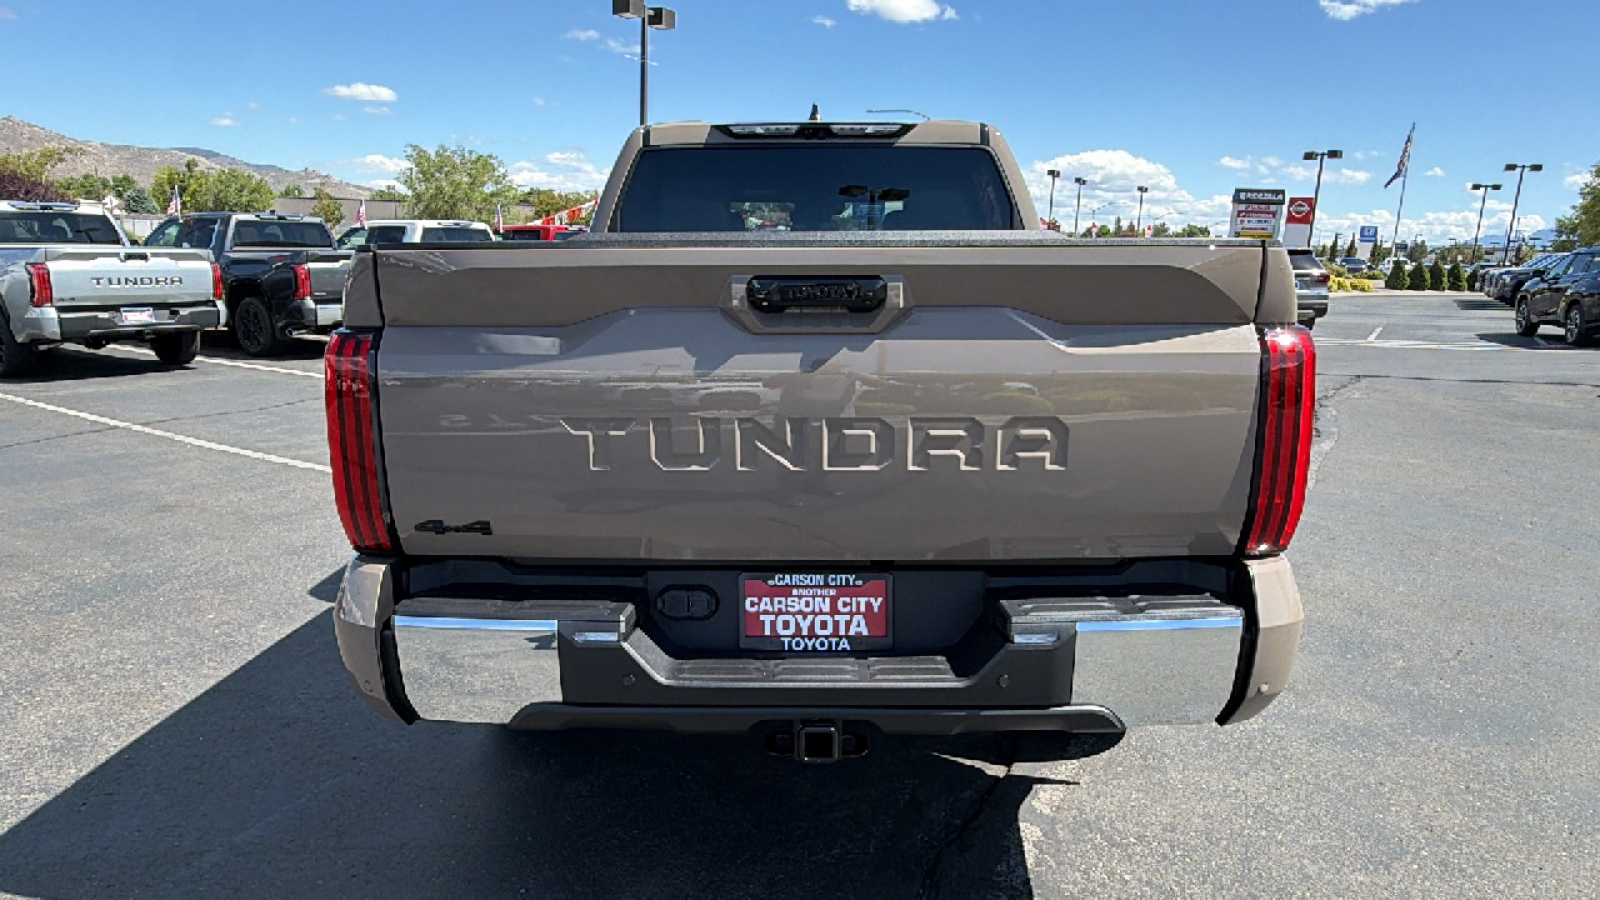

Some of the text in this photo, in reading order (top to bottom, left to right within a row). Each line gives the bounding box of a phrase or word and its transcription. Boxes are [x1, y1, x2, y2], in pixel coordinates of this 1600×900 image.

[91, 276, 183, 288] TUNDRA
[788, 285, 849, 300] TOYOTA
[558, 416, 1070, 471] TUNDRA
[775, 574, 856, 586] CARSON CITY
[791, 588, 837, 596] ANOTHER
[745, 597, 883, 612] CARSON CITY
[759, 615, 869, 636] TOYOTA
[781, 637, 850, 650] TOYOTA
